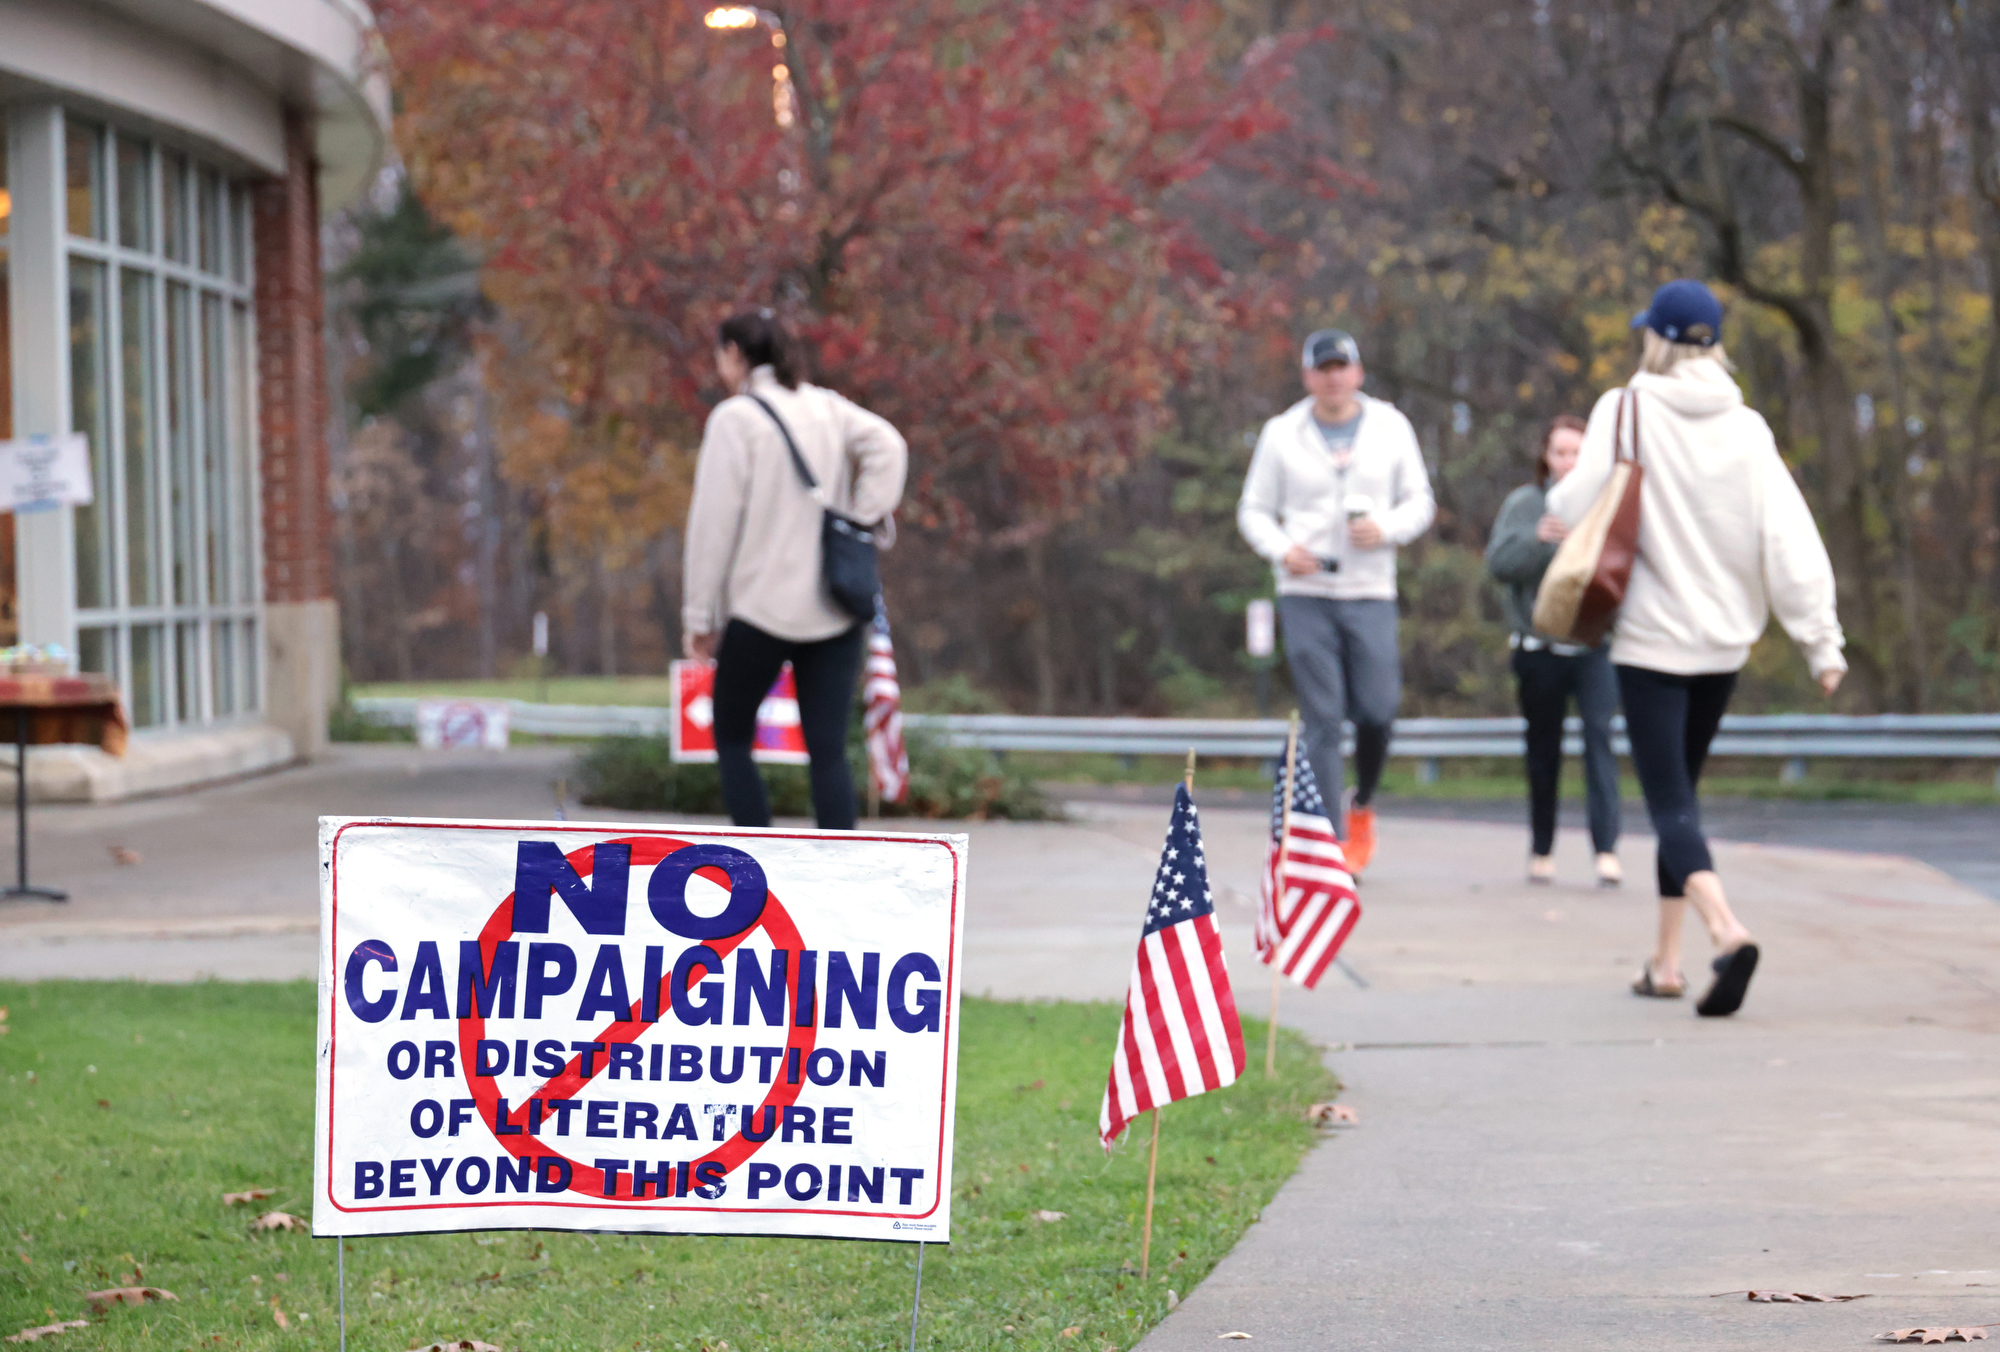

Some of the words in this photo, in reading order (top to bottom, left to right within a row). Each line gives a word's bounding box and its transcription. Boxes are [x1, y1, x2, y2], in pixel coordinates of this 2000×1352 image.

[512, 841, 767, 940] NO
[345, 939, 941, 1033] CAMPAIGNING
[387, 1041, 455, 1079] OR
[476, 1040, 886, 1087] DISTRIBUTION
[411, 1099, 476, 1138] OF
[496, 1099, 853, 1145] LITERATURE
[355, 1157, 572, 1199] BEYOND
[595, 1159, 727, 1199] THIS
[748, 1163, 923, 1205] POINT
